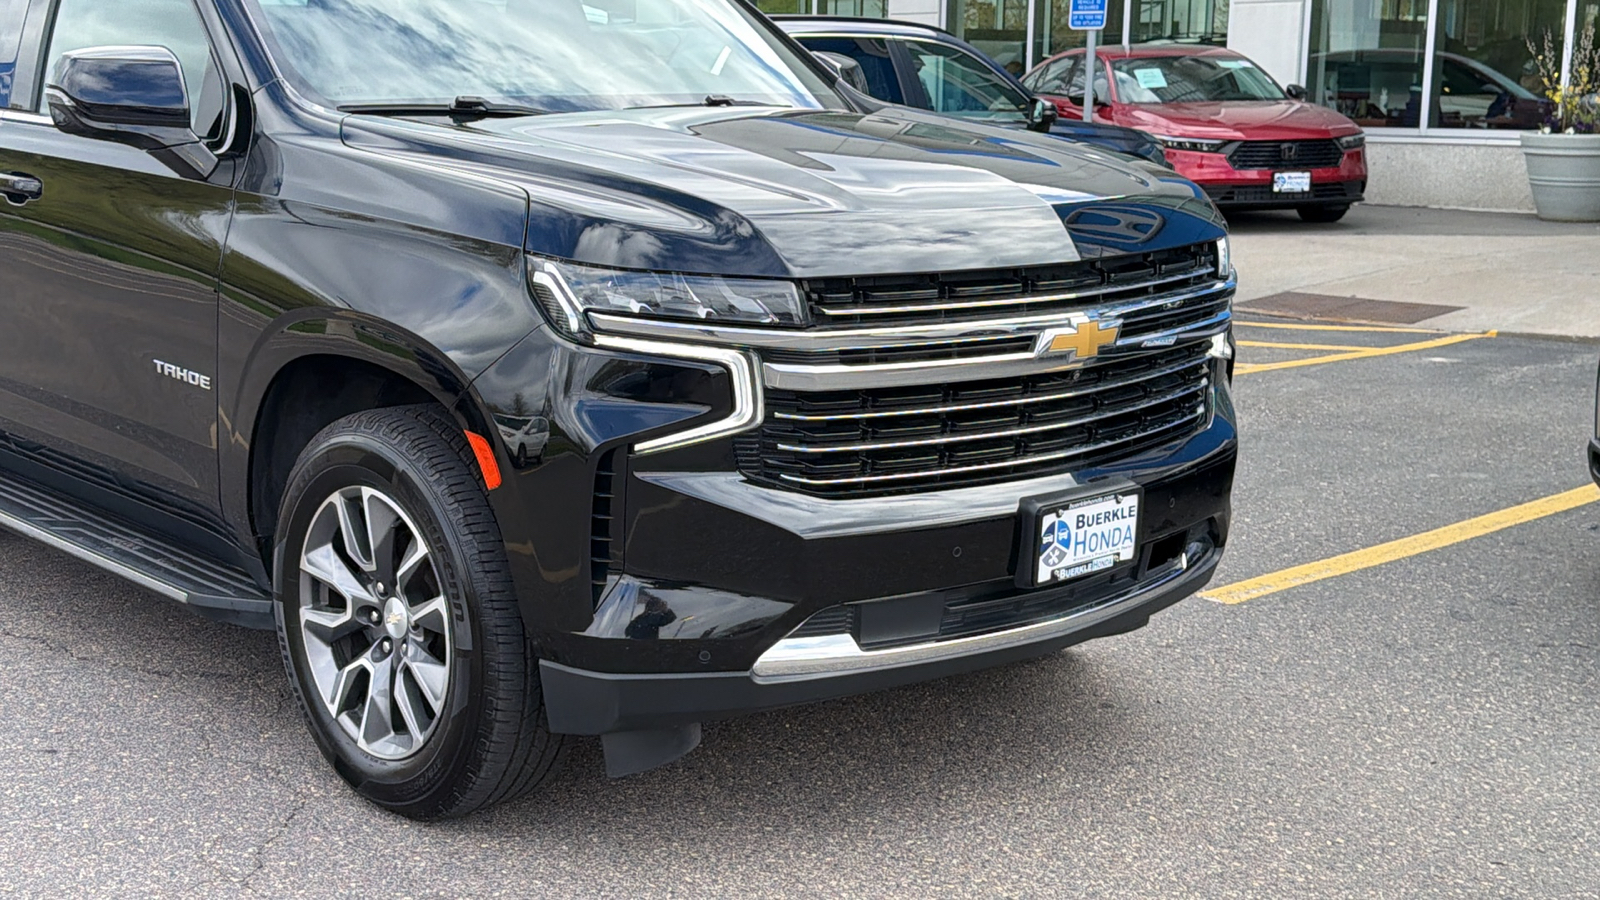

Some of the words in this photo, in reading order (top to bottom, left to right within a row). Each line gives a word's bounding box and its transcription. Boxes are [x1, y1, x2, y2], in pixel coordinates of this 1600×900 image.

[153, 359, 211, 390] TAHOE
[1075, 505, 1136, 530] BUERKLE
[1073, 524, 1133, 557] HONDA
